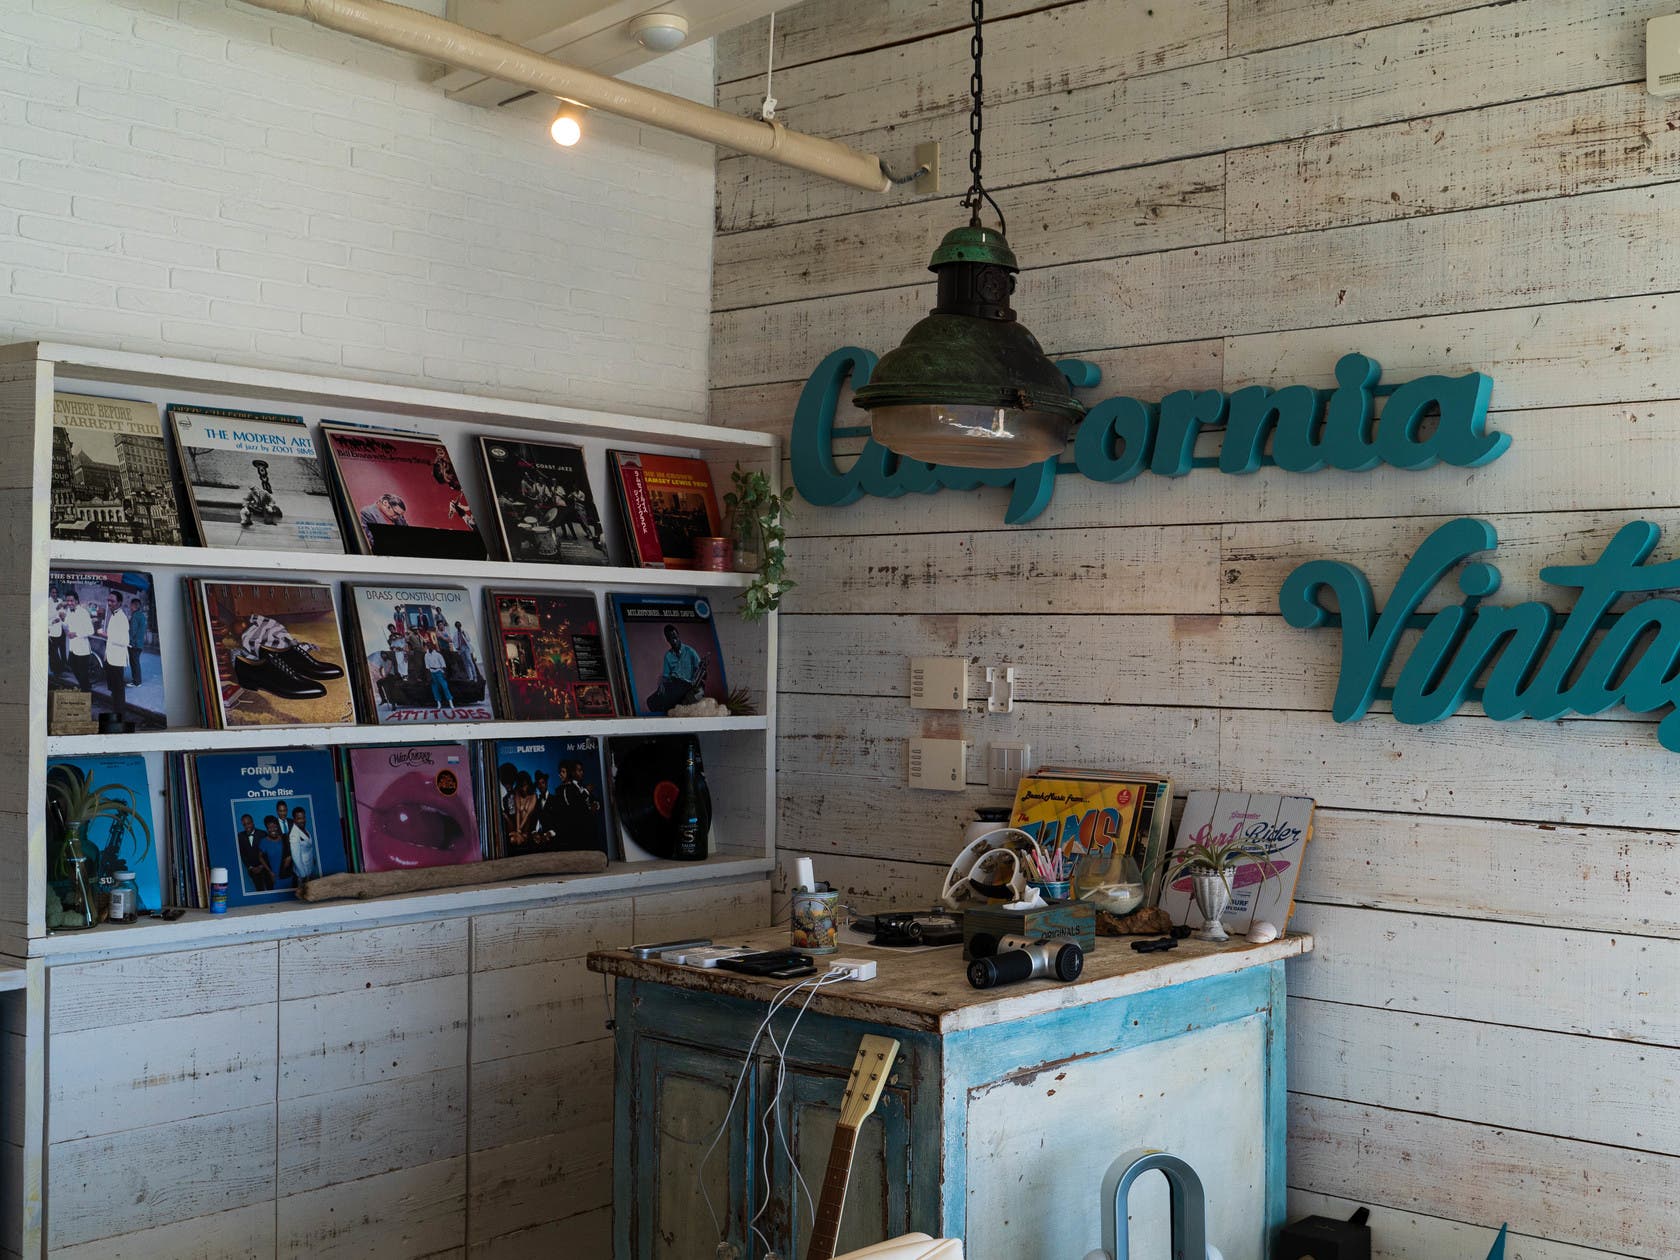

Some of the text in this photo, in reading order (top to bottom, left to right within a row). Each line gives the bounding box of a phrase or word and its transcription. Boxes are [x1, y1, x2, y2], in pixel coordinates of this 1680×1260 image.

[97, 403, 133, 421] BEFORE
[61, 415, 159, 435] JARRETT TRIO
[204, 428, 312, 448] THE MODERN ART
[245, 444, 259, 452] jazz
[260, 445, 269, 453] by
[271, 446, 293, 454] ZOOT
[297, 448, 314, 456] SIMS
[535, 463, 556, 471] COAST
[66, 573, 108, 581] STYLISTICS
[366, 590, 461, 602] BRASS CONSTRUCTION
[386, 708, 491, 721] ATTITUDES
[517, 744, 545, 753] PLAYERS
[576, 742, 596, 751] MEAN
[241, 765, 294, 776] FORMULA
[257, 755, 279, 788] 5
[261, 789, 277, 797] The
[277, 788, 294, 796] Rise
[1022, 791, 1043, 802] Beach
[1044, 792, 1065, 801] Music
[1018, 813, 1029, 822] The
[1245, 820, 1301, 843] Rider
[1041, 925, 1080, 938] ORIGINALS
